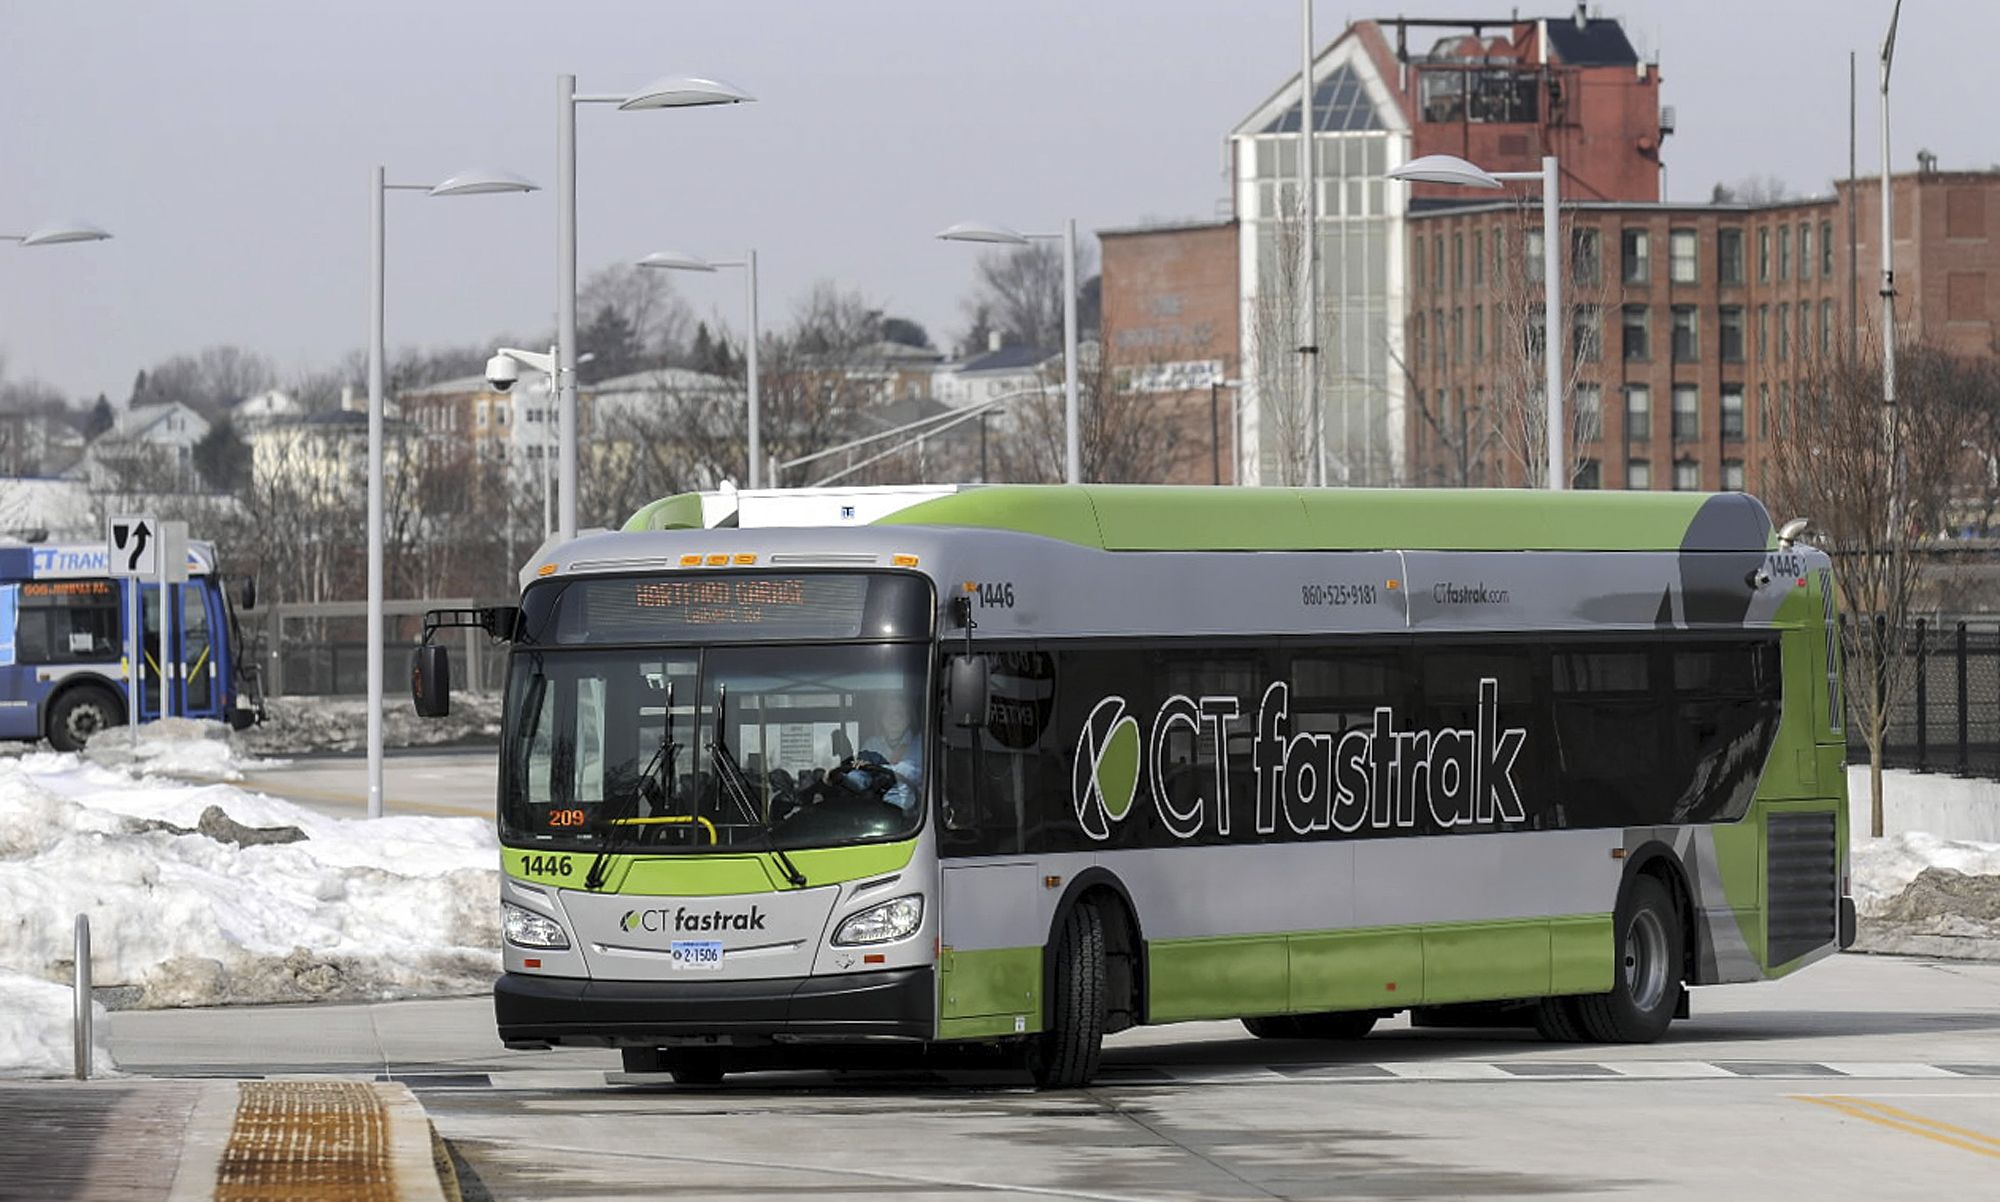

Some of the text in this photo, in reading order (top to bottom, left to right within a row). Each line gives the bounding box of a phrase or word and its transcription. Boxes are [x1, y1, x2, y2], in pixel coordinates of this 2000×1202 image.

[1769, 555, 1801, 578] 1446
[977, 582, 1014, 608] 1446
[1149, 677, 1527, 839] CT fastrak
[548, 809, 585, 827] 209
[521, 856, 573, 876] 1446
[641, 905, 766, 932] CT fastrak
